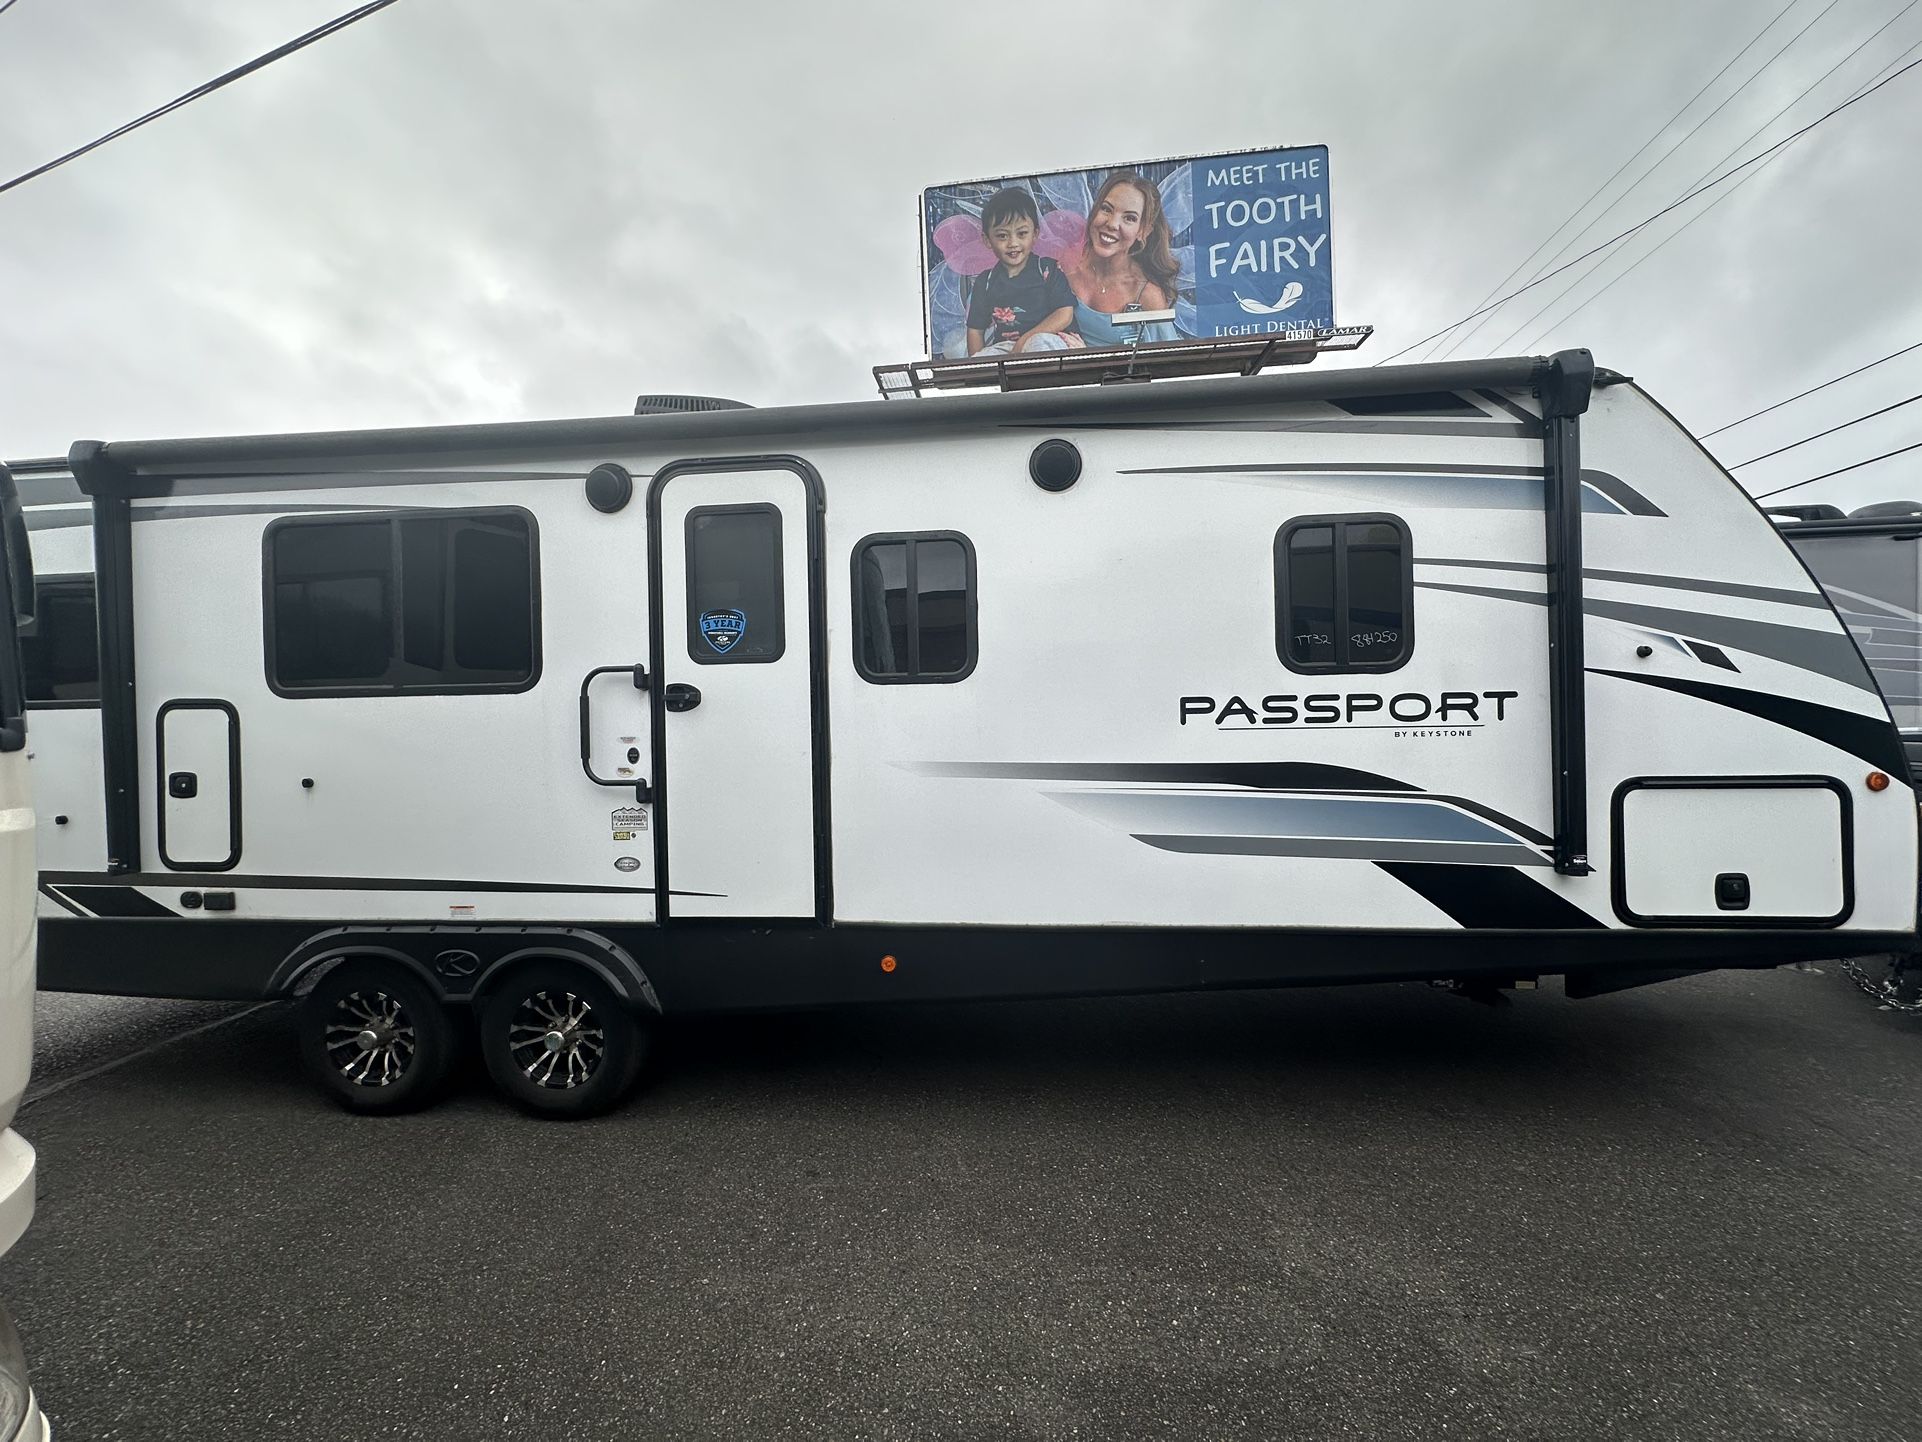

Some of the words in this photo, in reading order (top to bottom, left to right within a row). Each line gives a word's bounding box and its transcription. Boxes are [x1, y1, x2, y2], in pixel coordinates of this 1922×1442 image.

[1207, 165, 1268, 187] MEET
[1275, 159, 1320, 181] THE
[1204, 193, 1323, 229] TOOTH
[1208, 233, 1327, 278] FAIRY
[1215, 324, 1261, 337] LIGHT
[1267, 318, 1324, 333] DENTAL
[1287, 330, 1312, 340] 41570
[1322, 326, 1368, 336] LAMAR
[704, 621, 711, 630] 3
[713, 620, 741, 629] YEAR
[1180, 691, 1519, 725] PASSPORT
